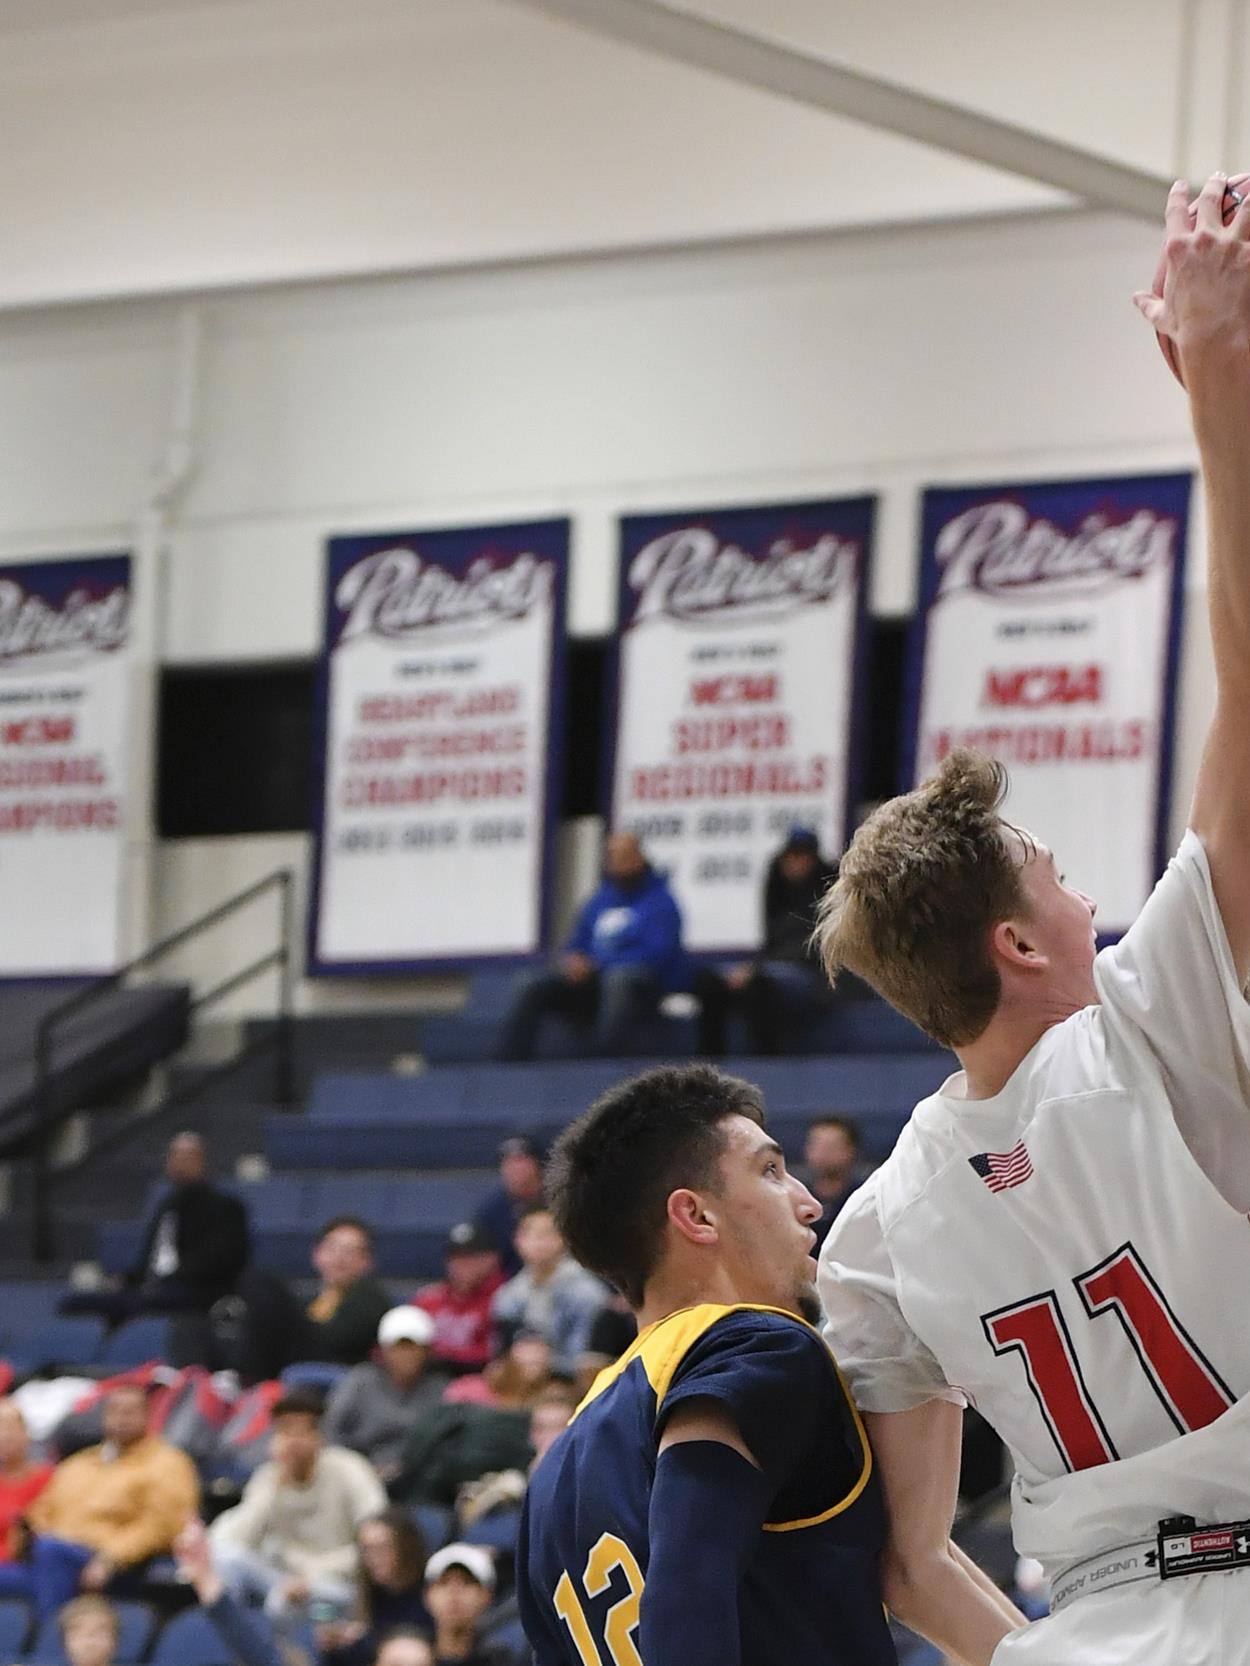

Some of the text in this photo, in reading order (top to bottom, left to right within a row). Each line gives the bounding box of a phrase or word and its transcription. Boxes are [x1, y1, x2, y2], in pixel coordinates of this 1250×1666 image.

[935, 500, 1176, 597] Patriots
[335, 547, 555, 645] Patriots
[629, 526, 858, 620] Patriots
[690, 671, 777, 708] NCAA
[983, 663, 1104, 709] NCAA
[673, 714, 787, 755] SUPER
[343, 768, 525, 809] CHAMPIONS
[631, 756, 829, 803] REGIONALS
[980, 1240, 1239, 1475] 11
[1192, 1536, 1231, 1549] AUTHENTIC
[1089, 1557, 1138, 1582] UNDER
[553, 1531, 646, 1666] 12
